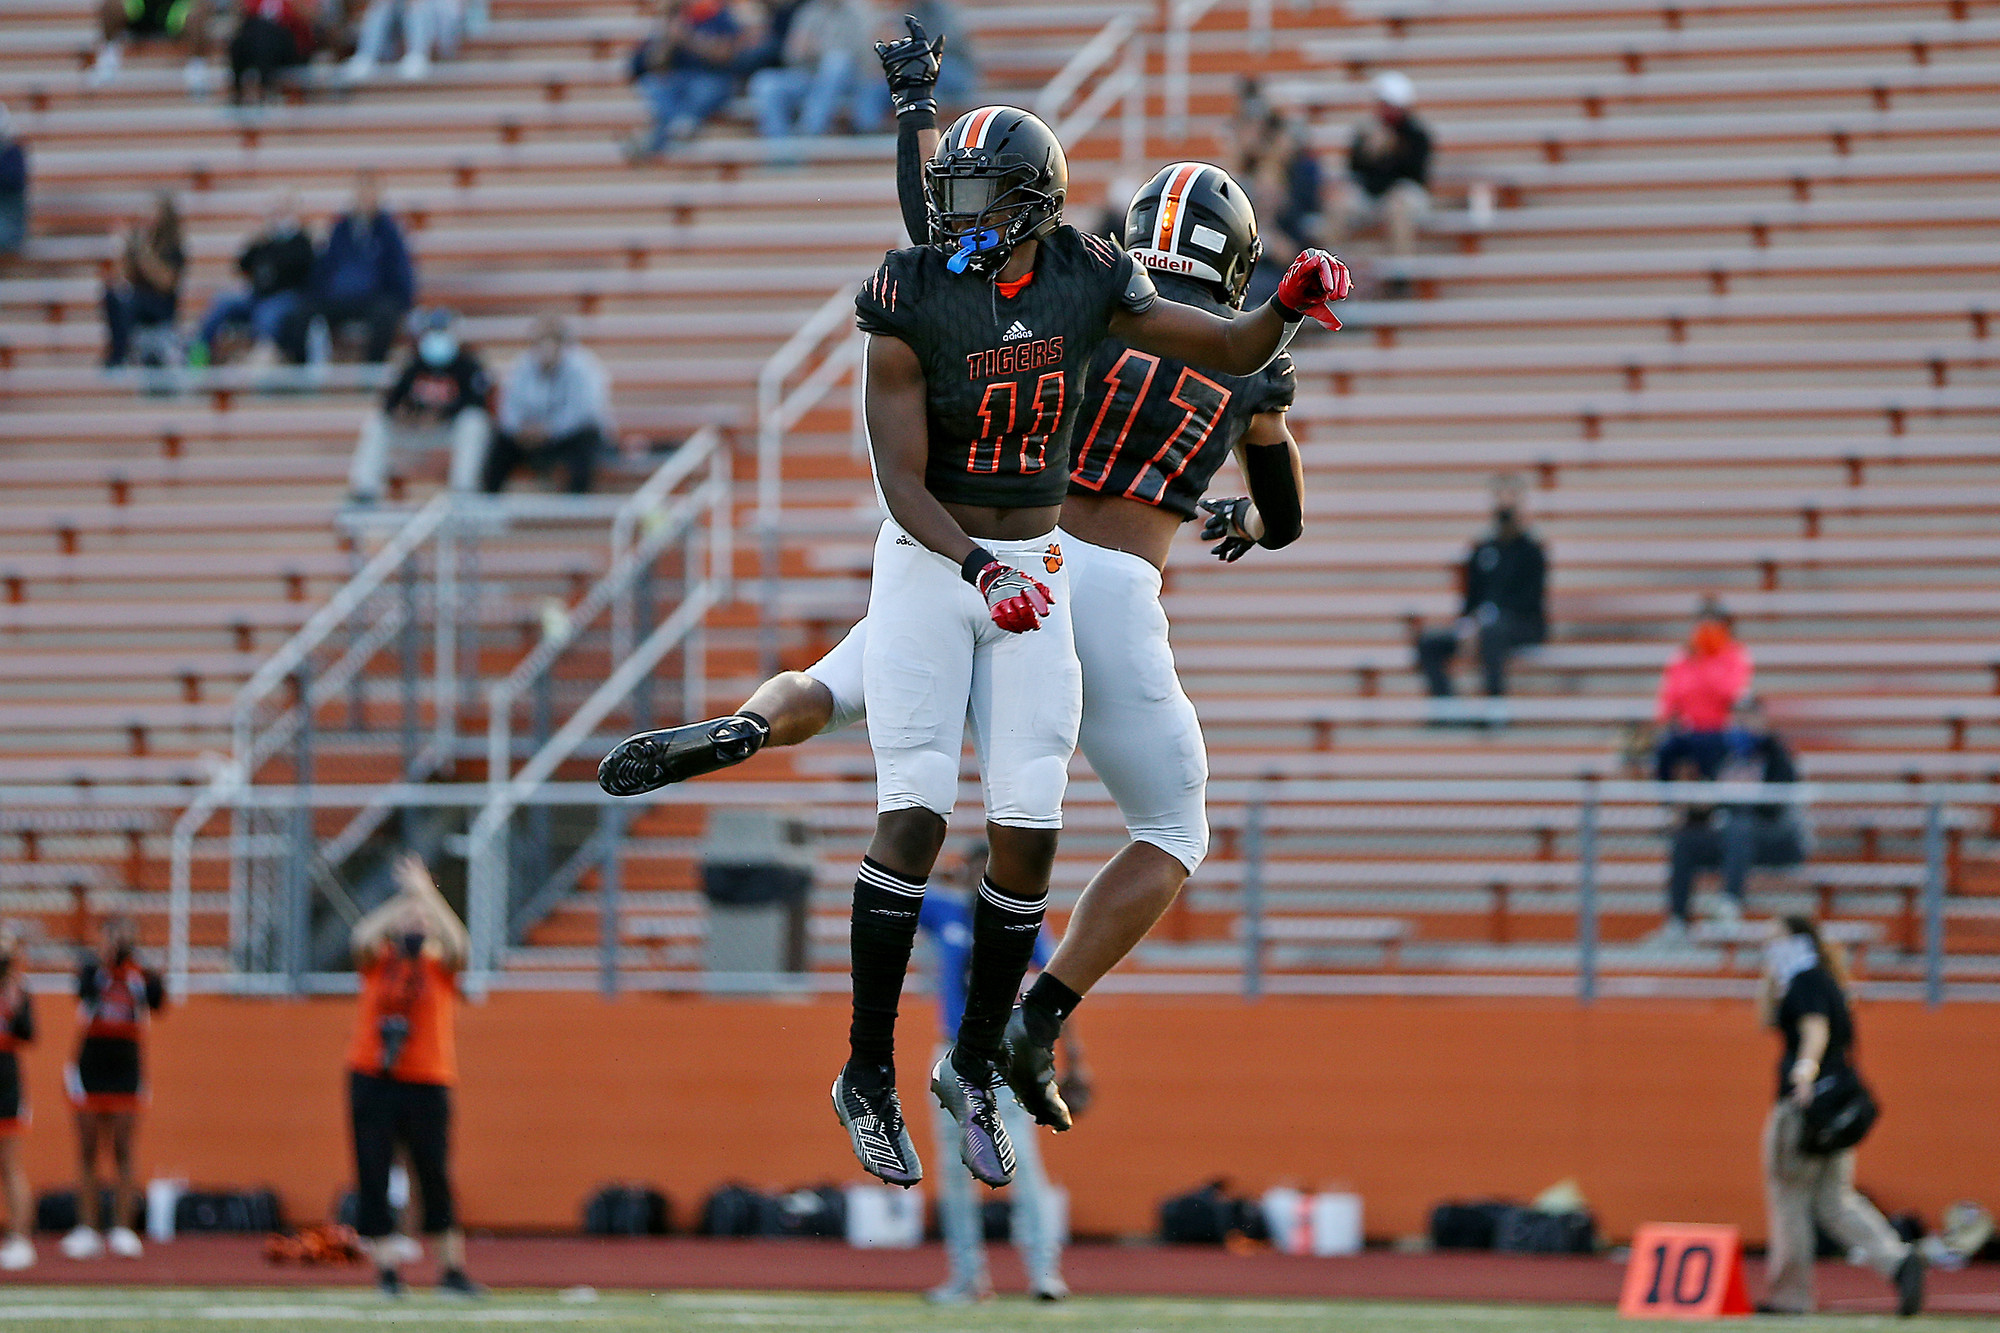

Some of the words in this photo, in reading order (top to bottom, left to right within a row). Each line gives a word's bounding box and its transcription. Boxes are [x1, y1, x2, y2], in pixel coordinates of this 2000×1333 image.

[1133, 251, 1194, 273] Riddell
[966, 336, 1064, 380] TIGERS
[1002, 329, 1033, 342] adidas
[966, 370, 1065, 474] 11
[1070, 347, 1233, 506] 17
[1646, 1246, 1713, 1304] 10
